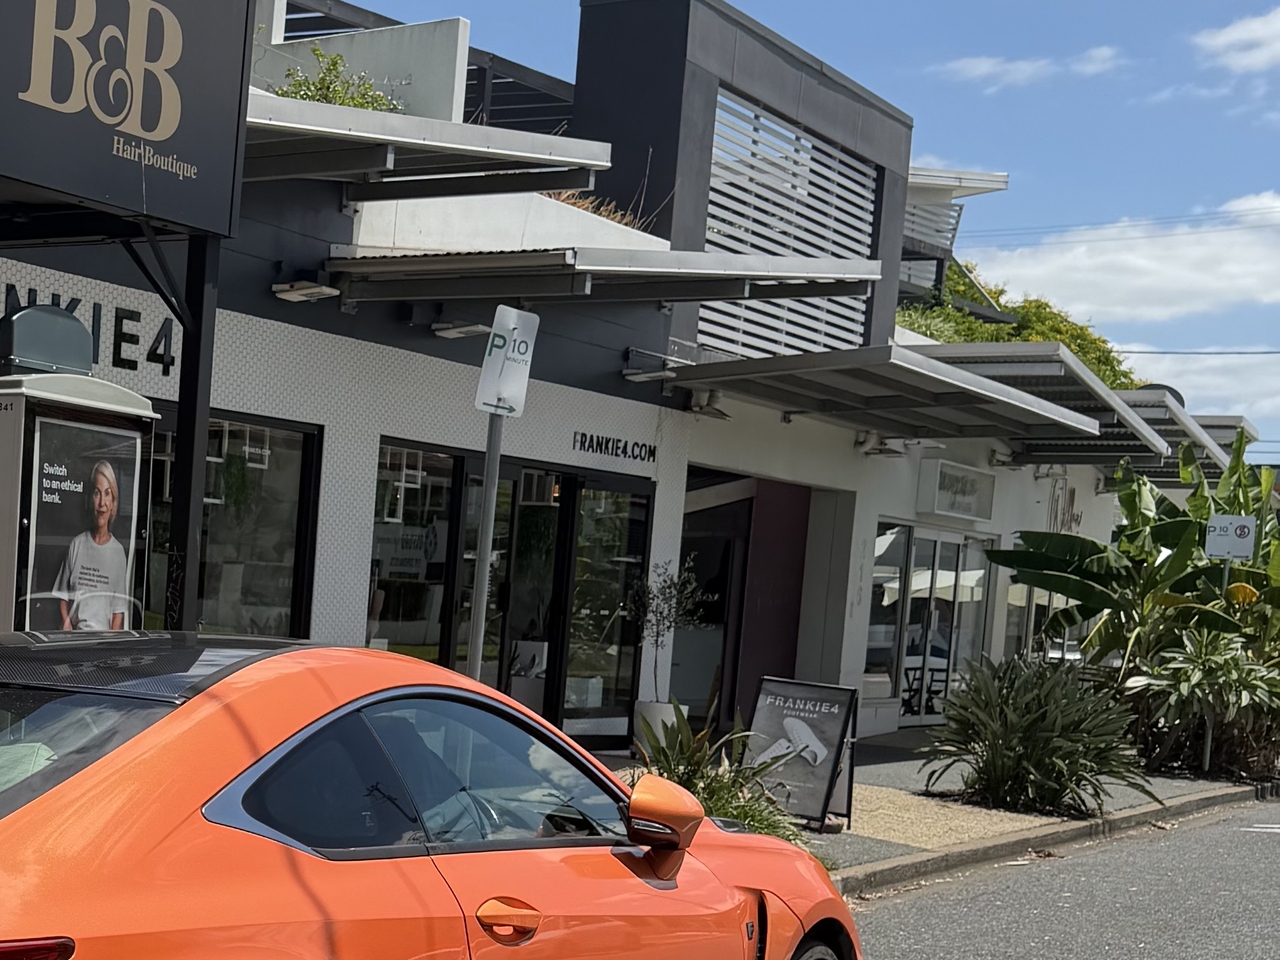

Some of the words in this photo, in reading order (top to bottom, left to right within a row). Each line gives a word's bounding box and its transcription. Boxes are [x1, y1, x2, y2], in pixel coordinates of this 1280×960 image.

[18, 0, 183, 141] B&B
[112, 135, 141, 162] Hair
[144, 145, 198, 180] Boutique
[488, 332, 507, 357] P
[512, 338, 529, 355] 10
[572, 431, 657, 463] FRANKIE4.COM
[43, 462, 67, 477] Switch
[43, 478, 50, 488] to
[51, 481, 60, 490] an
[61, 480, 84, 493] ethical
[42, 491, 61, 504] bank.
[1219, 525, 1229, 533] 10
[766, 695, 839, 714] FRANKIE4
